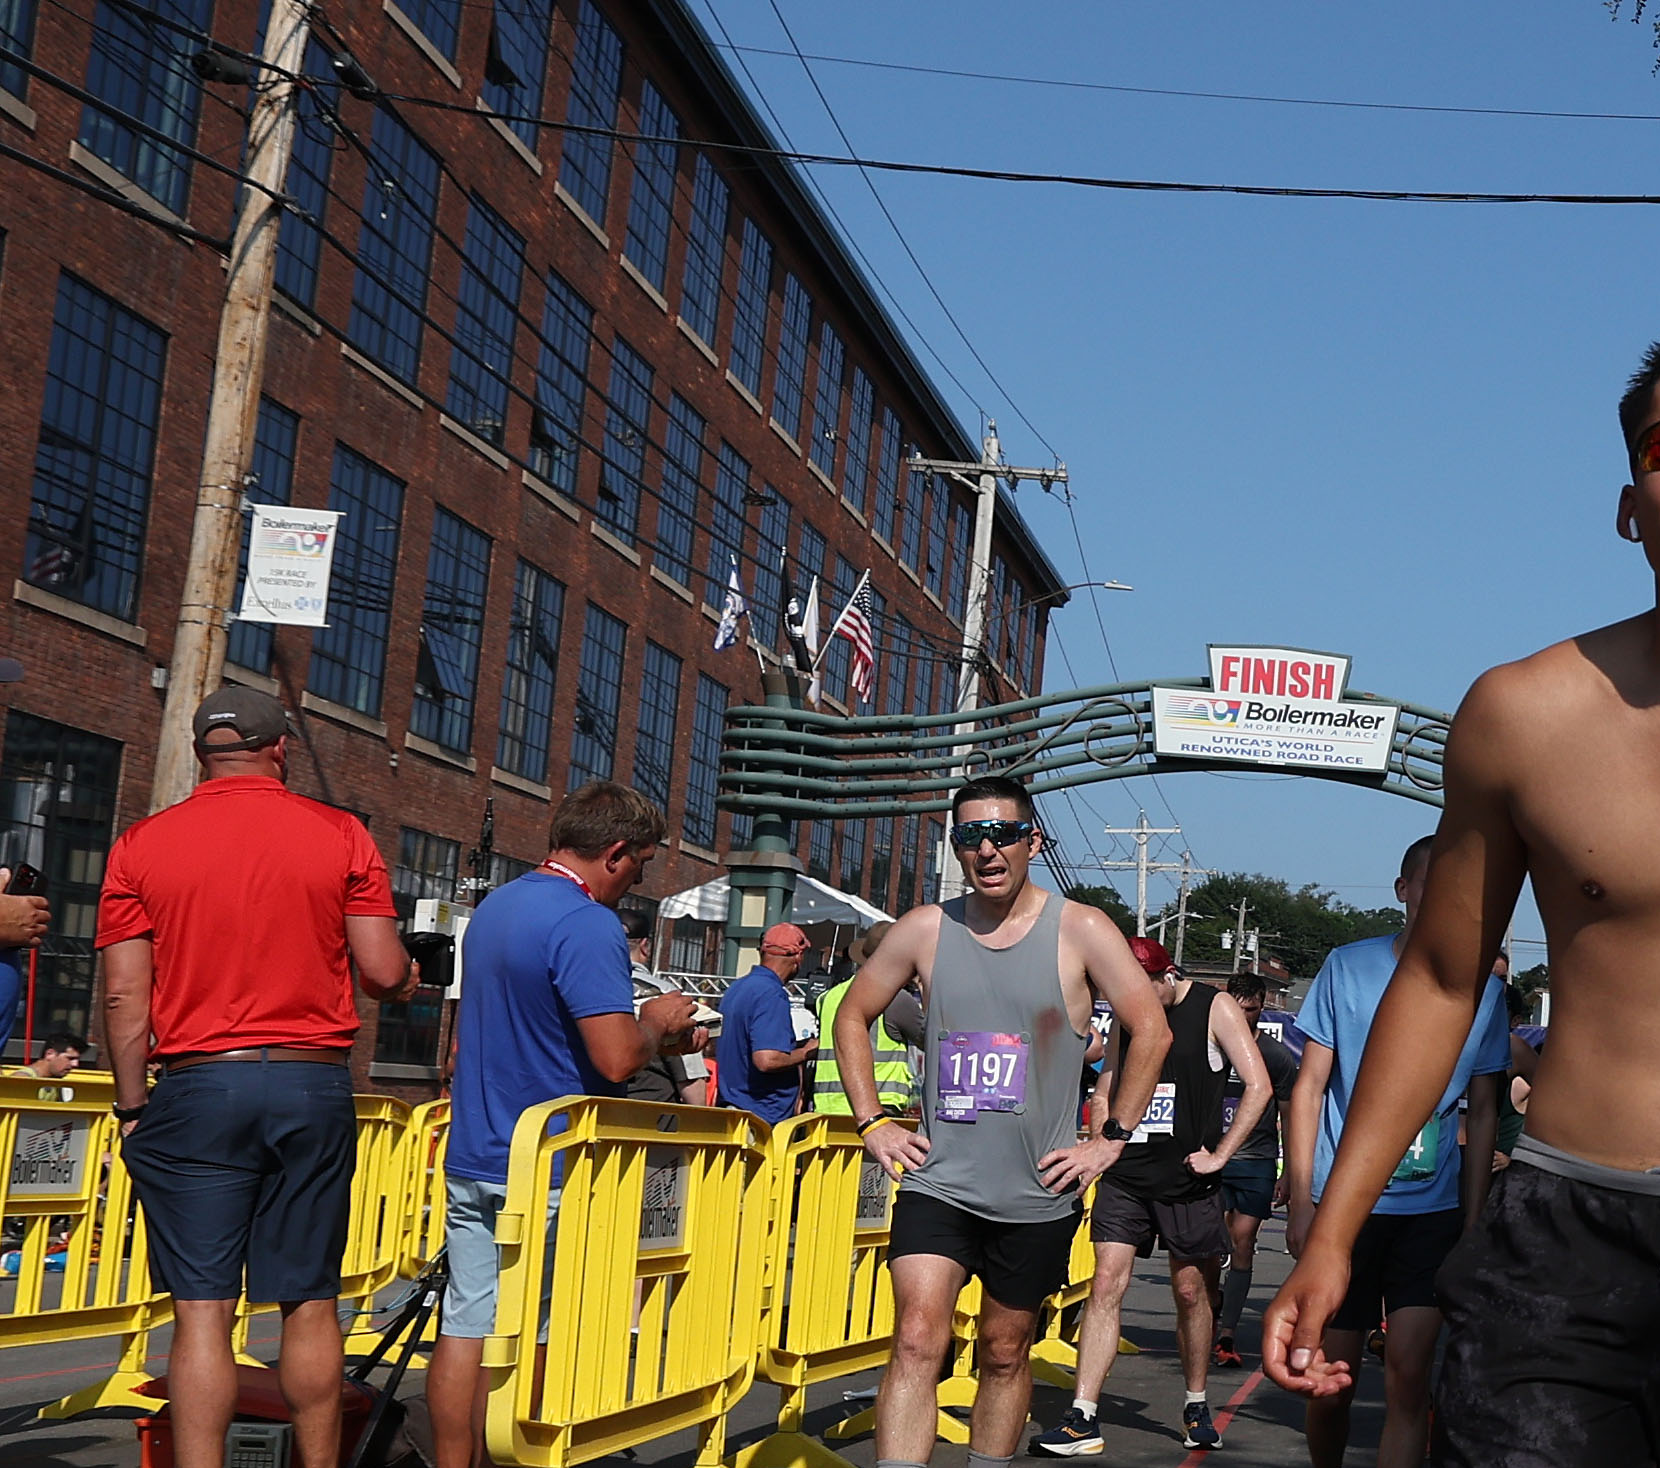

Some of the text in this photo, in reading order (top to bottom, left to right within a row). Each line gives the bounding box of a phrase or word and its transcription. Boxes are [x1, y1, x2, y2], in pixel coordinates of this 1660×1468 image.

[262, 517, 335, 531] Boilermaker
[1220, 655, 1335, 701] FINISH
[1245, 700, 1385, 730] Boilermaker
[1244, 723, 1379, 740] MORE THAN A RACE
[1181, 743, 1364, 765] RENOWNED ROAD RACE
[1212, 735, 1334, 752] UTICA'S WORLD
[950, 1052, 1017, 1087] 1197
